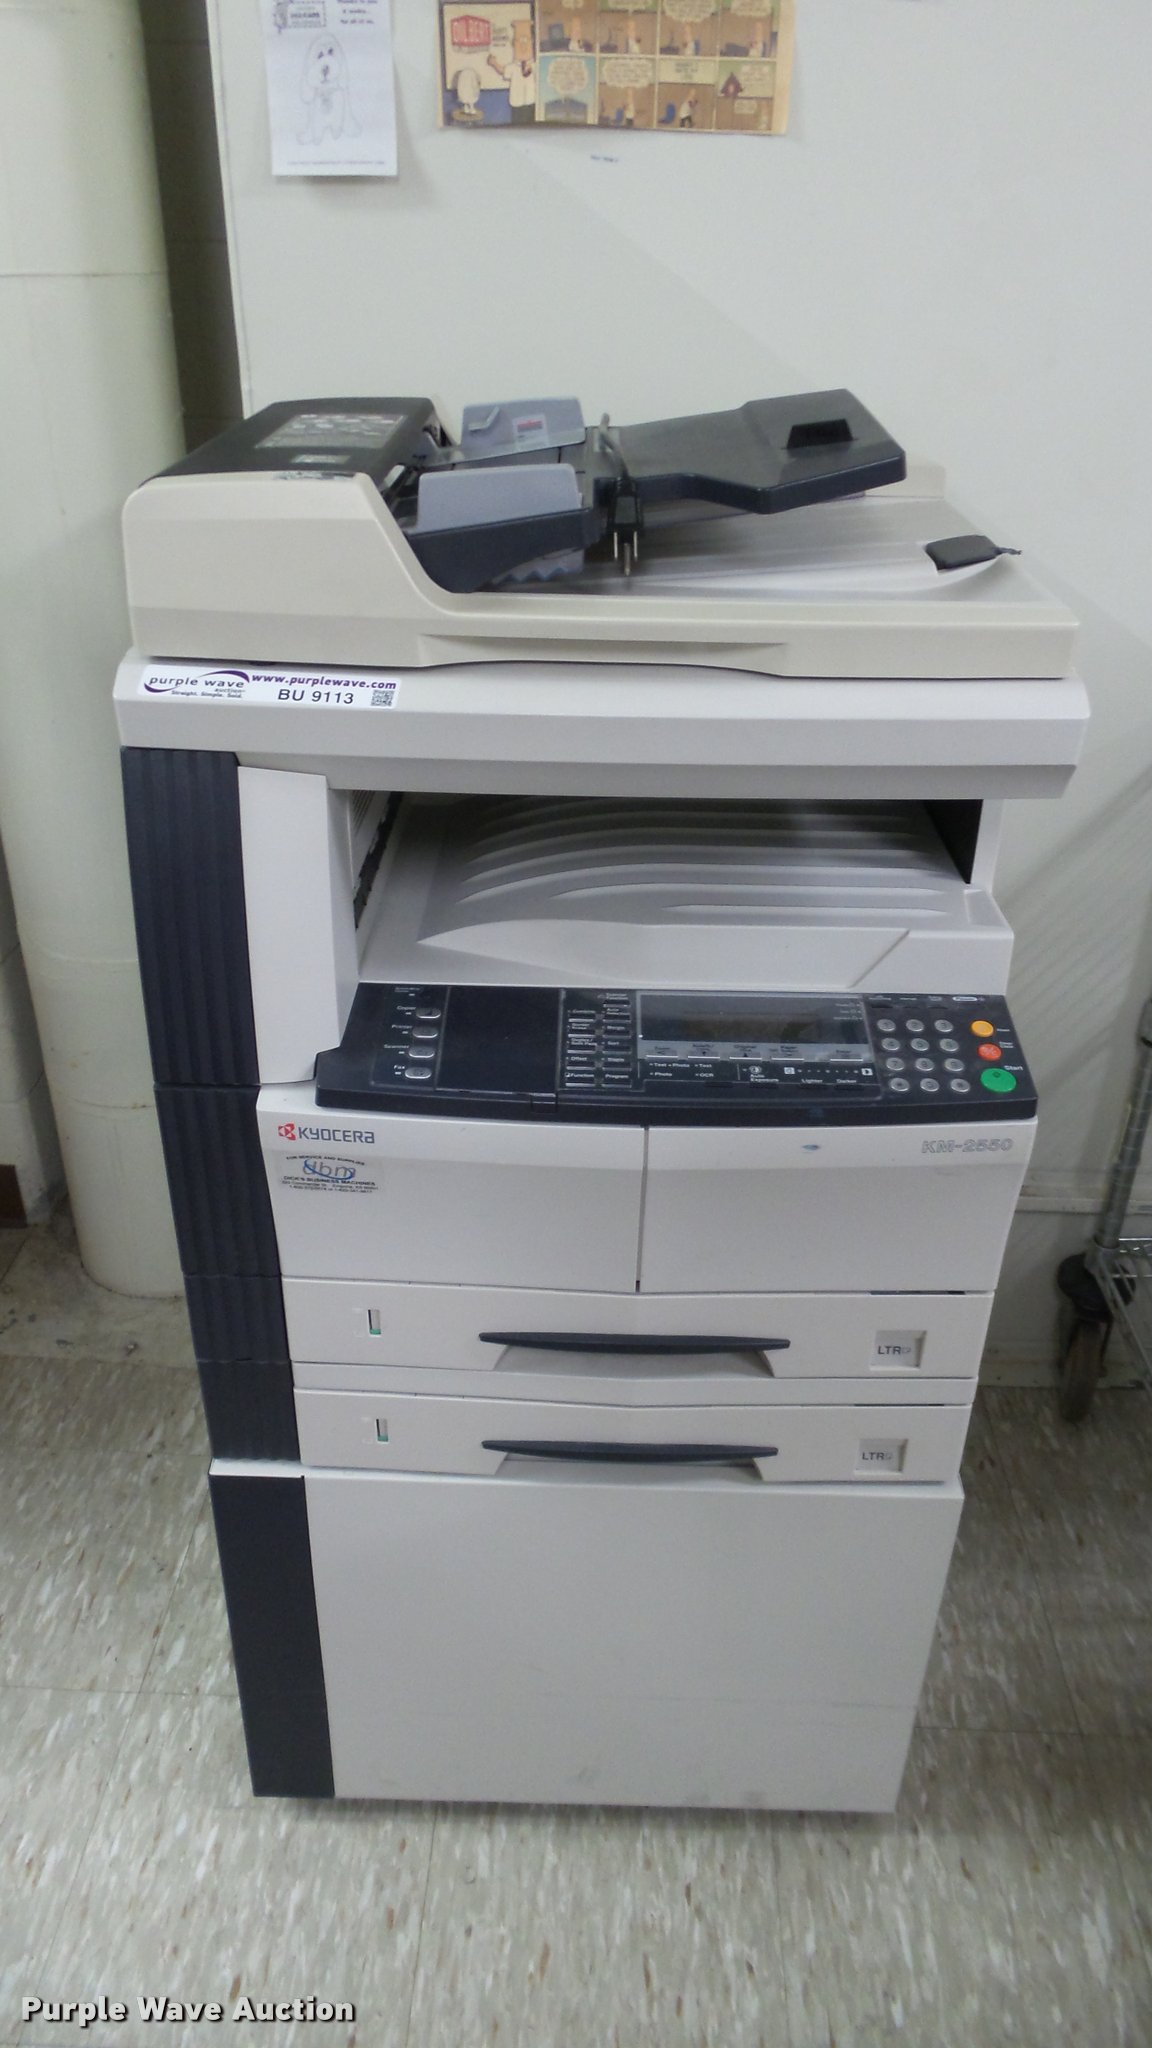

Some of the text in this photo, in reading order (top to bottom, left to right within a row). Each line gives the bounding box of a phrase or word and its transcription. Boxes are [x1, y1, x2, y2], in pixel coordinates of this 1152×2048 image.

[149, 677, 244, 688] purple wave
[252, 674, 397, 690] www.purplewave.com
[278, 689, 354, 704] BU 9113
[298, 1127, 375, 1144] KYOCERA
[921, 1138, 1015, 1154] KM-2550
[878, 1346, 902, 1355] LTR
[862, 1452, 885, 1460] LTR
